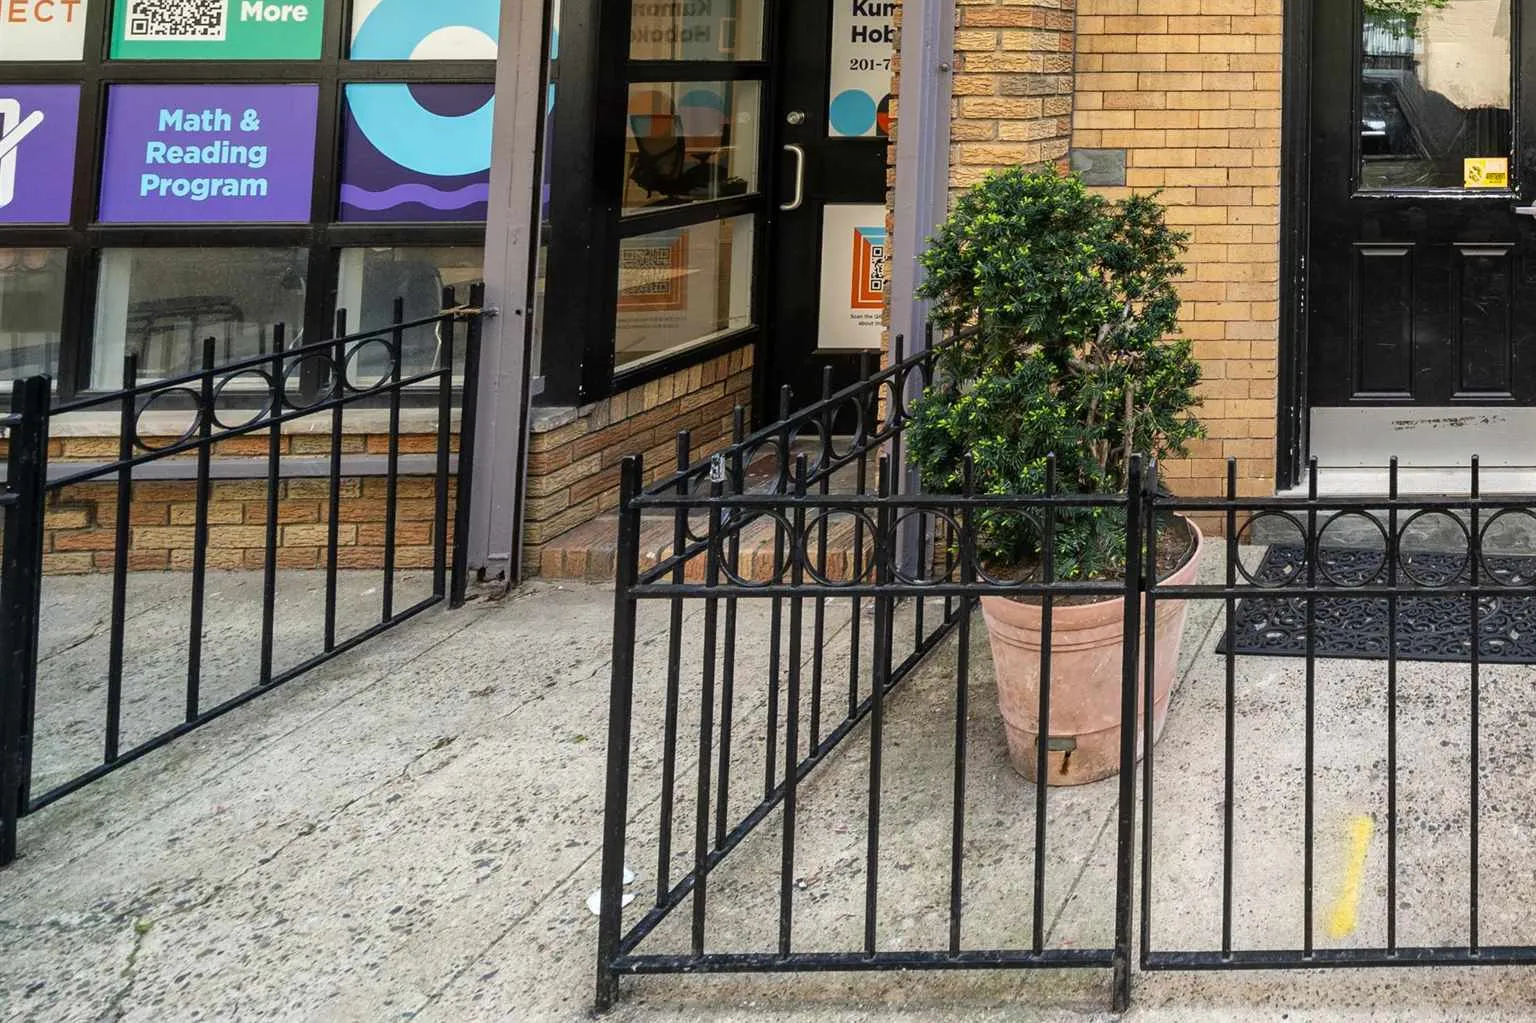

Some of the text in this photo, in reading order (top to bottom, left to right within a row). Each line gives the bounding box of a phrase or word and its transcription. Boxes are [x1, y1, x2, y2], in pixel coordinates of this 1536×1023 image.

[0, 0, 81, 23] ECT
[240, 0, 308, 22] More
[158, 108, 261, 132] Math &
[145, 140, 268, 169] Reading
[139, 173, 268, 201] Program
